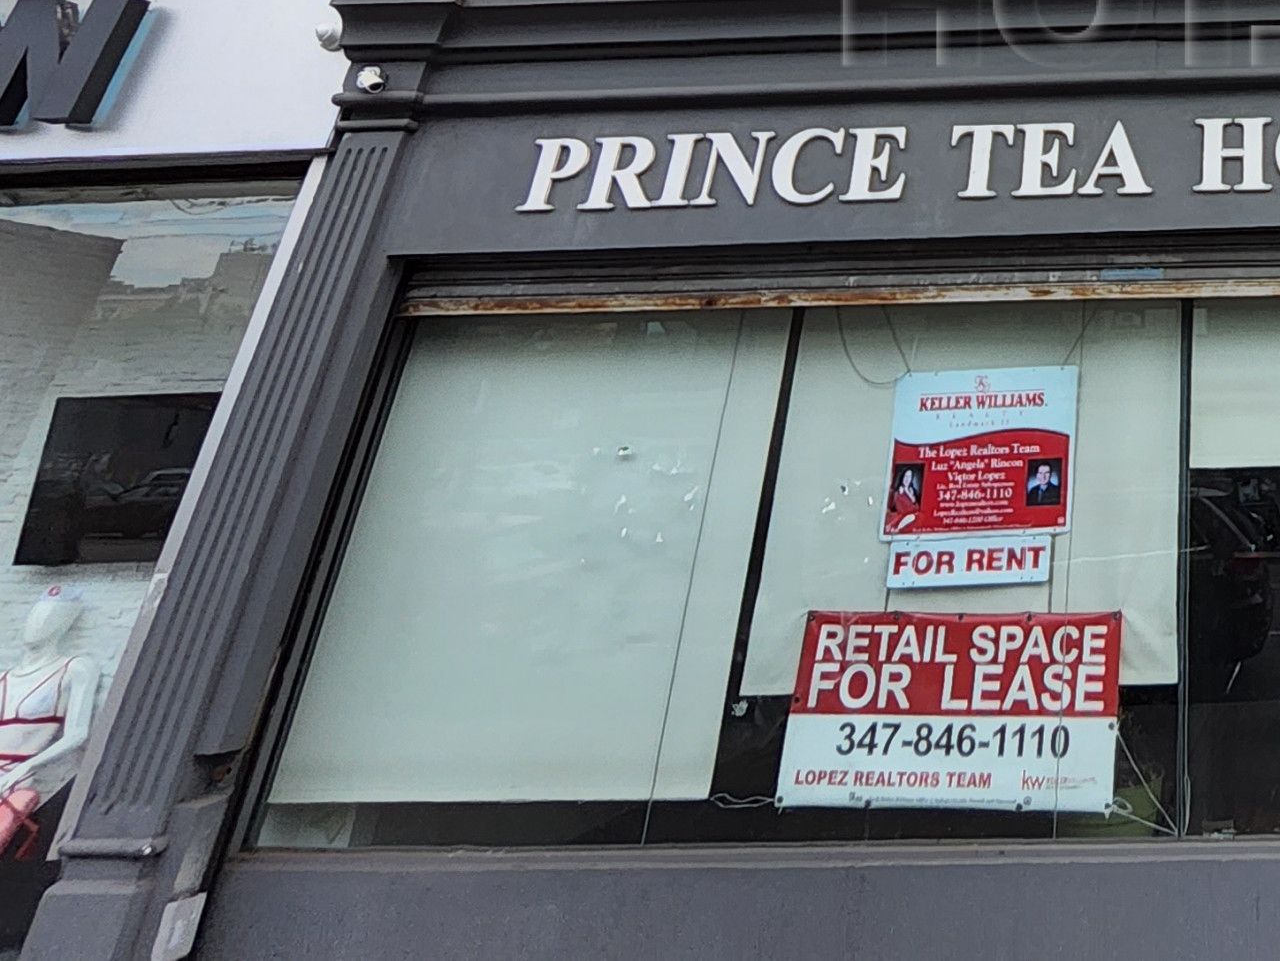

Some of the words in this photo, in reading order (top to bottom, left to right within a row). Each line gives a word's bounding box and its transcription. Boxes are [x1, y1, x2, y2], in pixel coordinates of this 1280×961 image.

[515, 126, 908, 213] PRINCE
[951, 120, 1154, 200] TEA
[919, 395, 972, 413] KELLER
[976, 391, 1046, 410] WILLIAMS
[919, 447, 938, 458] The
[940, 445, 968, 458] Lopez
[970, 444, 1010, 456] Realtors
[1011, 443, 1040, 454] Team
[931, 461, 948, 471] Luz
[990, 458, 1024, 469] Rincon
[948, 471, 977, 481] Victor
[978, 471, 1006, 483] Lopez
[938, 488, 1013, 501] 347-846-1110
[893, 550, 955, 576] FOR
[965, 546, 1046, 572] RENT
[815, 624, 957, 663] RETAIL
[969, 625, 1108, 664] SPACE
[806, 662, 912, 710] FOR
[940, 664, 1106, 712] LEASE
[835, 721, 1070, 759] 347-846-1110
[794, 769, 849, 786] LOPEZ
[853, 770, 940, 787] REALTORS
[946, 772, 992, 789] TEAM
